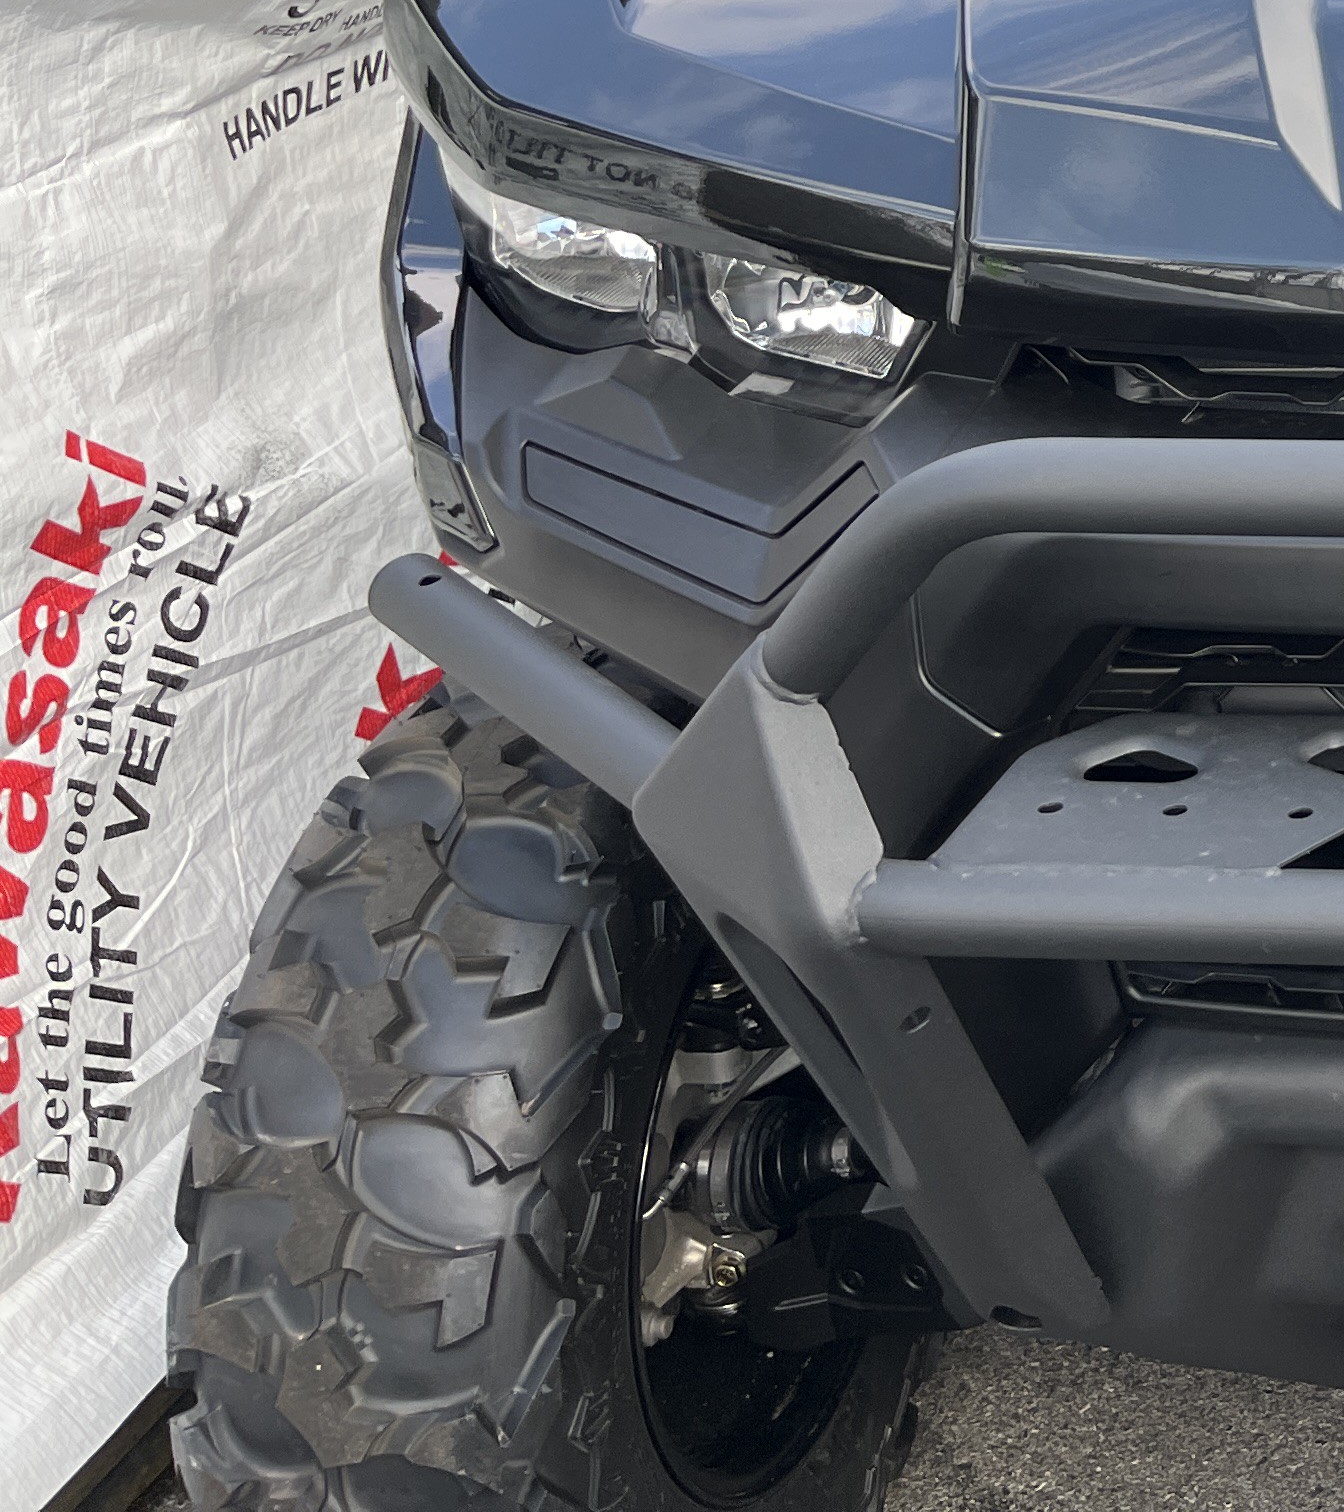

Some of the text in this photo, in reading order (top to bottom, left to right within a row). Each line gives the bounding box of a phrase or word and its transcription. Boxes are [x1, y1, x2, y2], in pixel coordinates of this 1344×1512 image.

[253, 9, 344, 37] KEEP DRY
[339, 2, 385, 32] HANDL
[222, 49, 390, 161] HANDLE WI
[77, 599, 138, 756] times
[46, 777, 99, 934] good
[83, 483, 251, 1207] UTILITY VEHICLE
[37, 951, 75, 1051] the
[36, 1074, 73, 1183] Let
